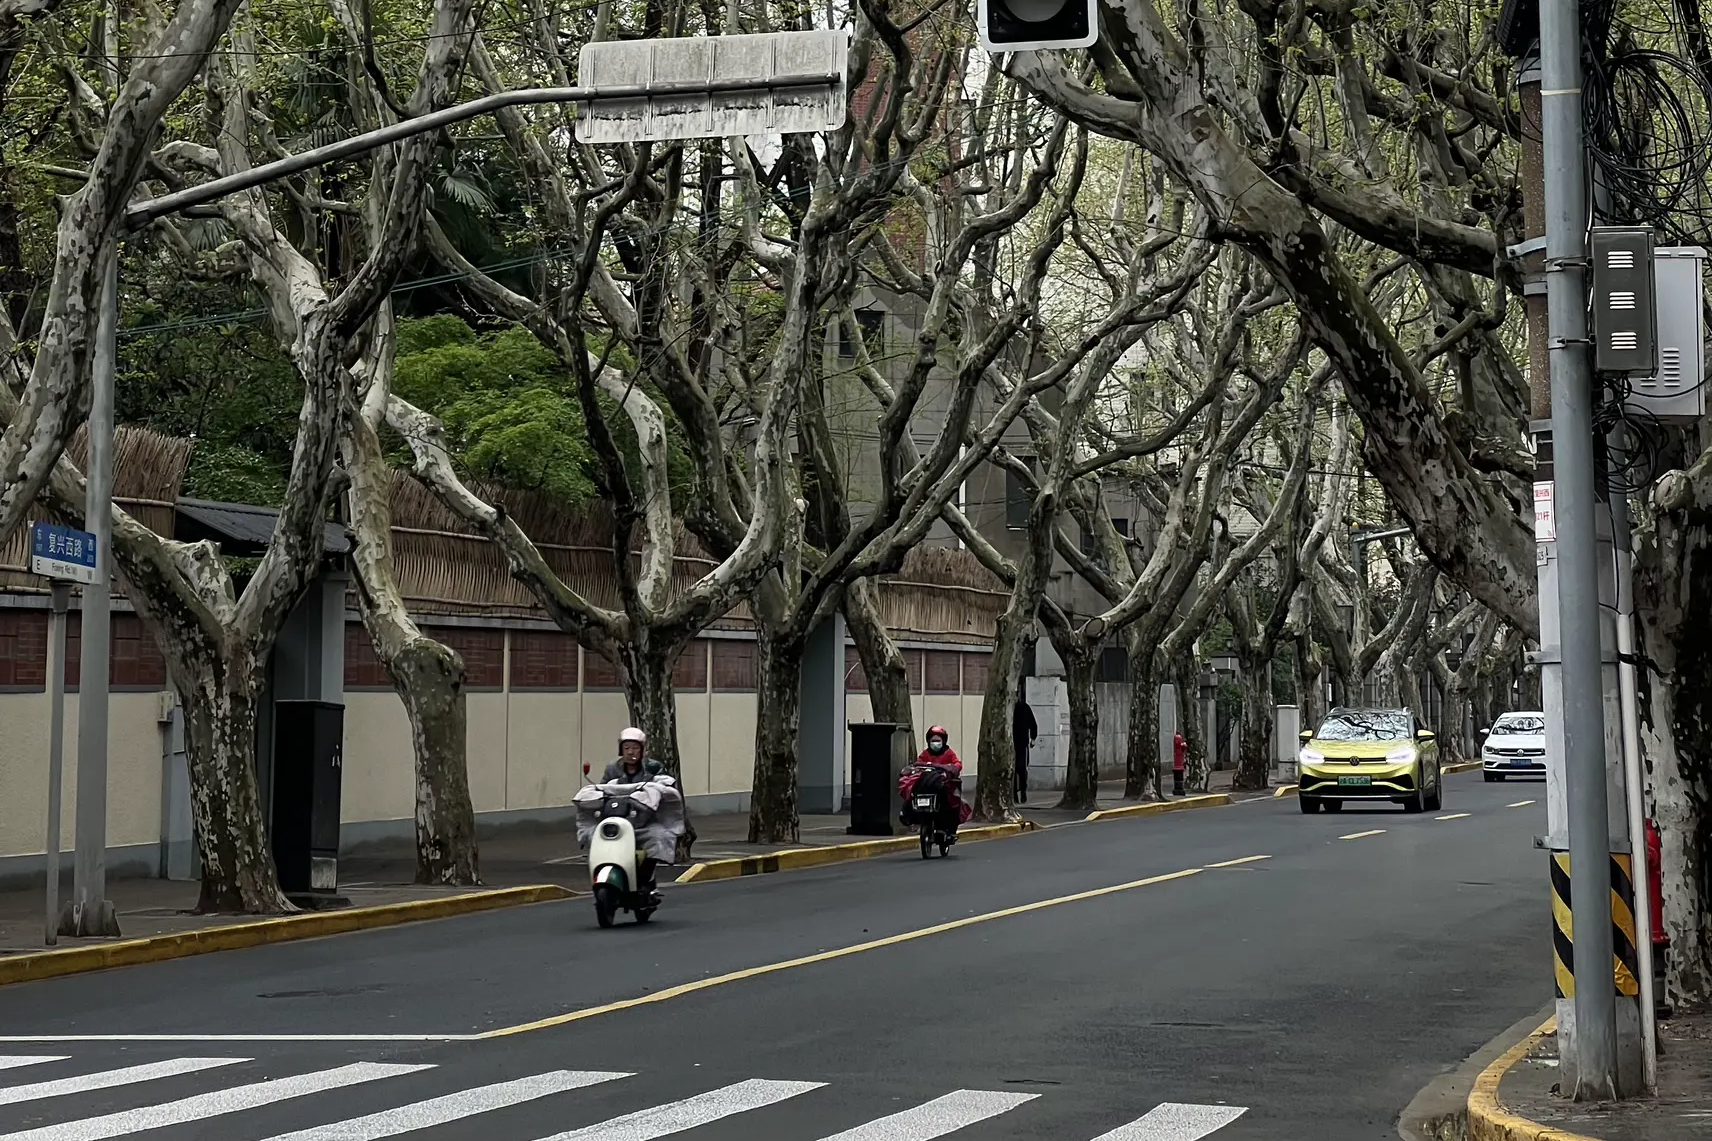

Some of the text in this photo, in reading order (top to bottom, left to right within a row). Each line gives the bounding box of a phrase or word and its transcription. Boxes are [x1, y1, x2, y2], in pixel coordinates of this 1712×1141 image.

[49, 533, 82, 558] 复兴西路
[36, 559, 41, 571] E
